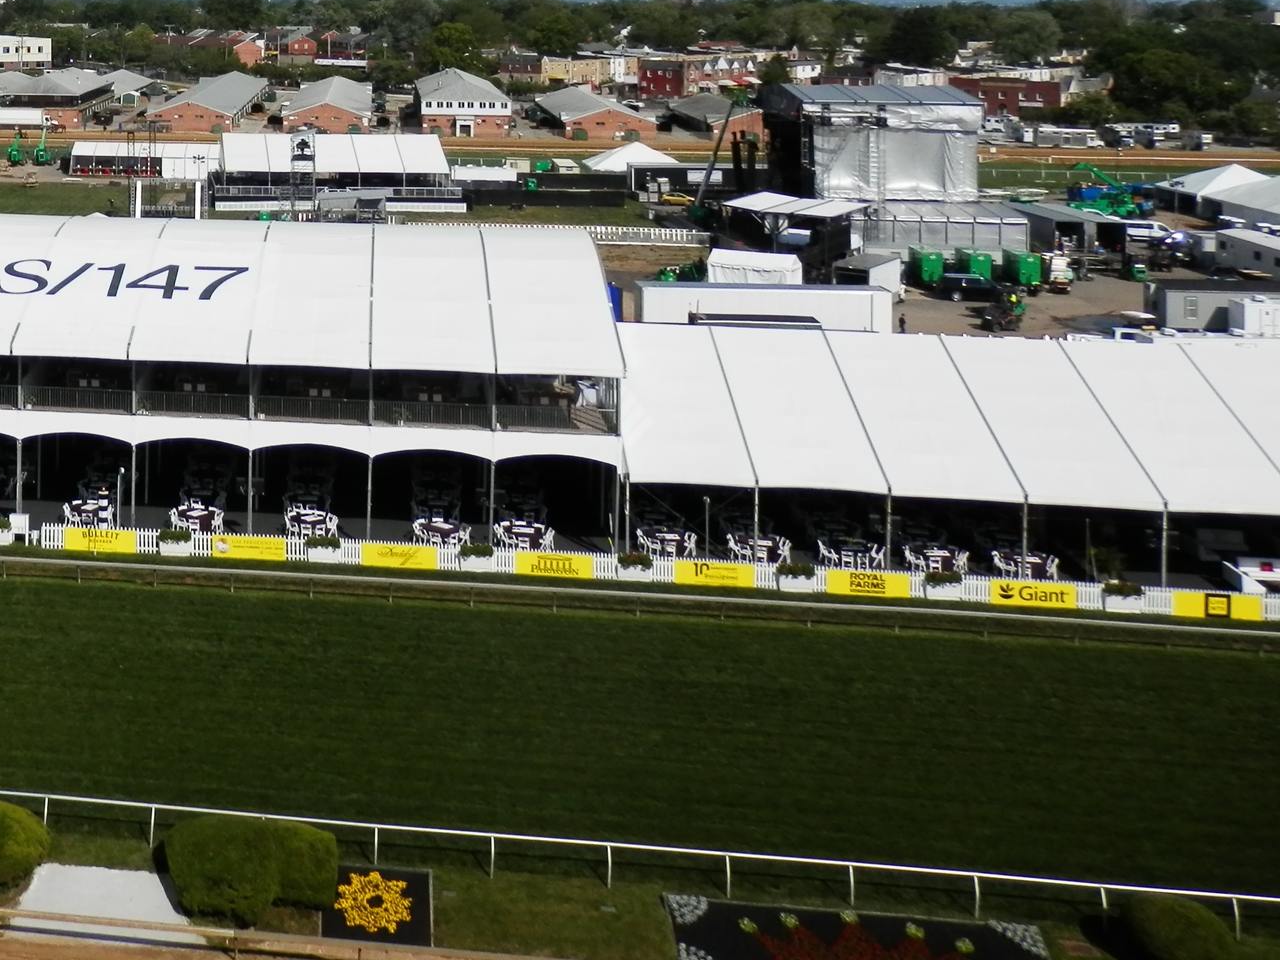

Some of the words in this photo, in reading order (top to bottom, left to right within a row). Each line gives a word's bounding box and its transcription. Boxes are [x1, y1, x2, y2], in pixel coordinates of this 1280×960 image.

[81, 530, 120, 541] BULLEIT
[849, 572, 886, 582] ROYAL
[849, 580, 886, 590] FARMS
[1019, 585, 1067, 603] Giant
